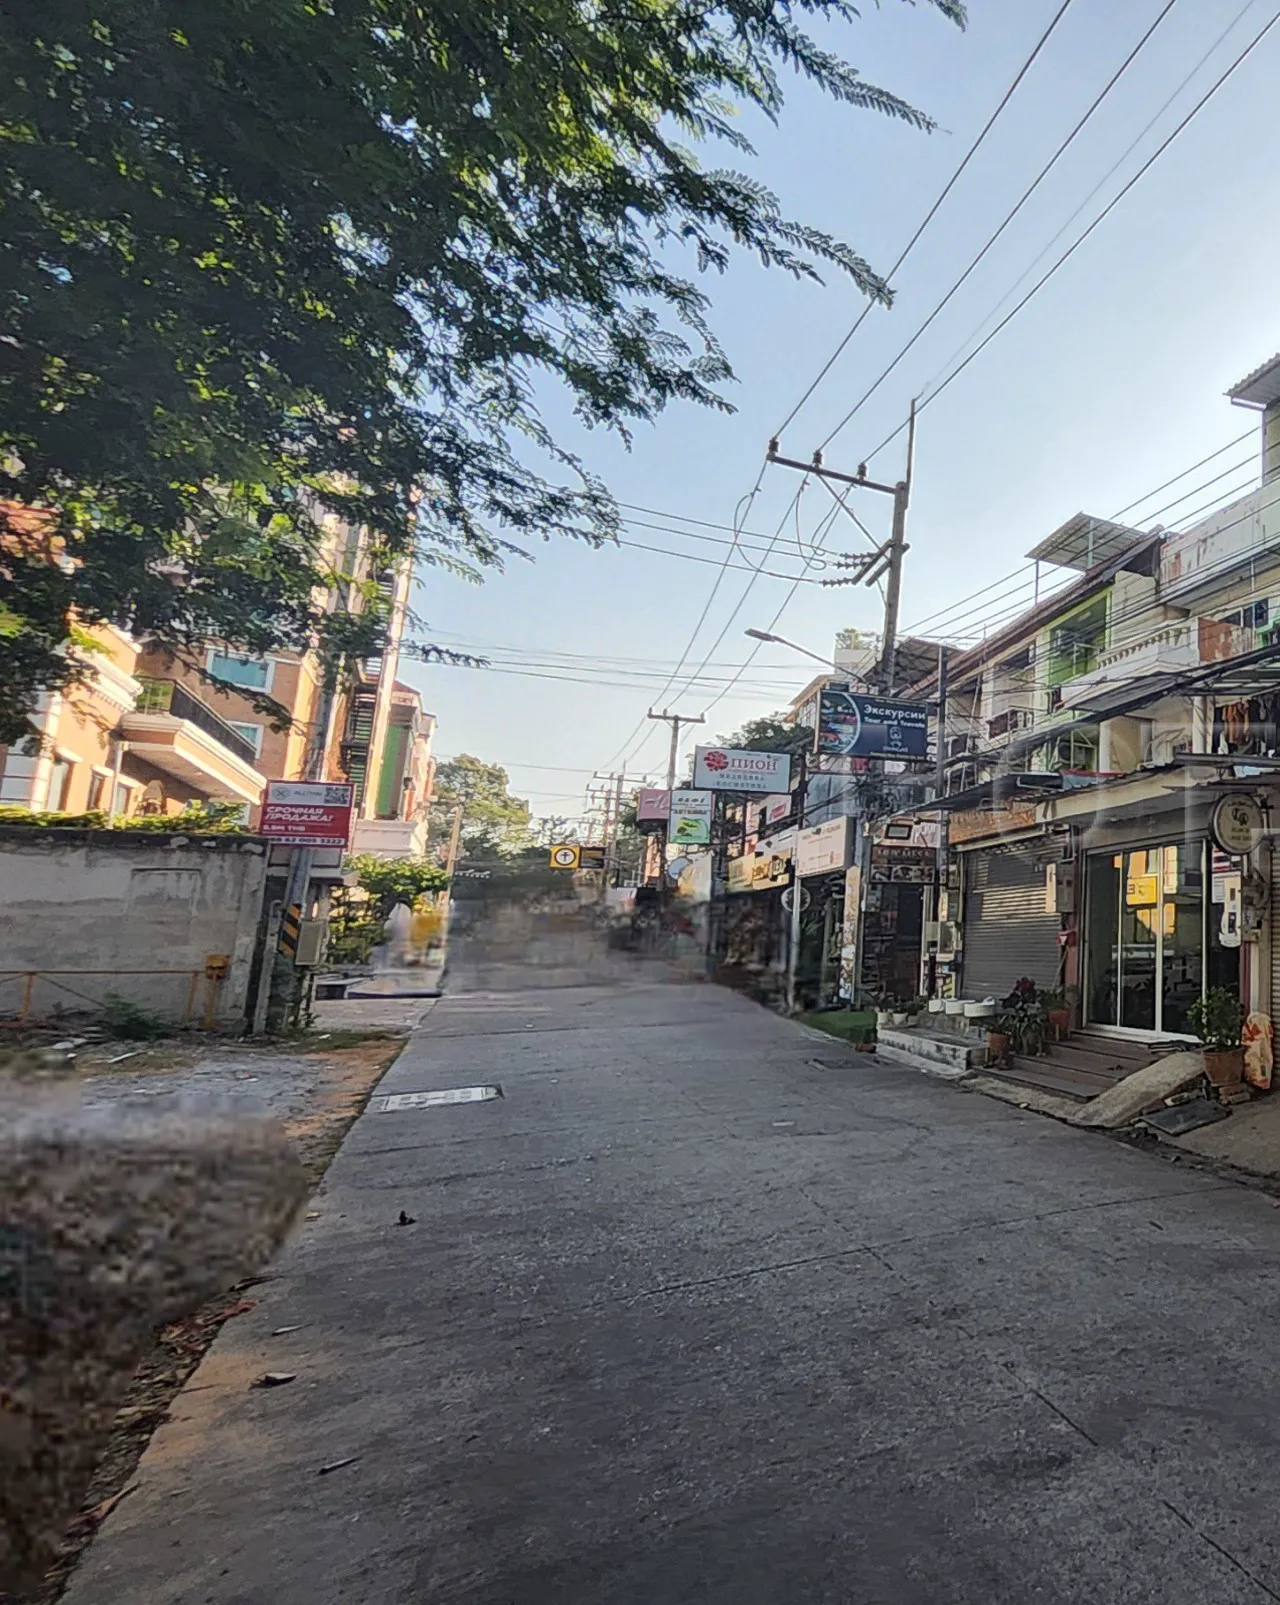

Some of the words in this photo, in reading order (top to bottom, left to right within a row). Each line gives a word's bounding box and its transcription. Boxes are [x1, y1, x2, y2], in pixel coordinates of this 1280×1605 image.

[863, 703, 926, 721] Экскурсии
[731, 758, 777, 771] ПИОН
[266, 806, 324, 814] СРОЧНАЯ
[264, 814, 334, 822] ПРОДАЖА!
